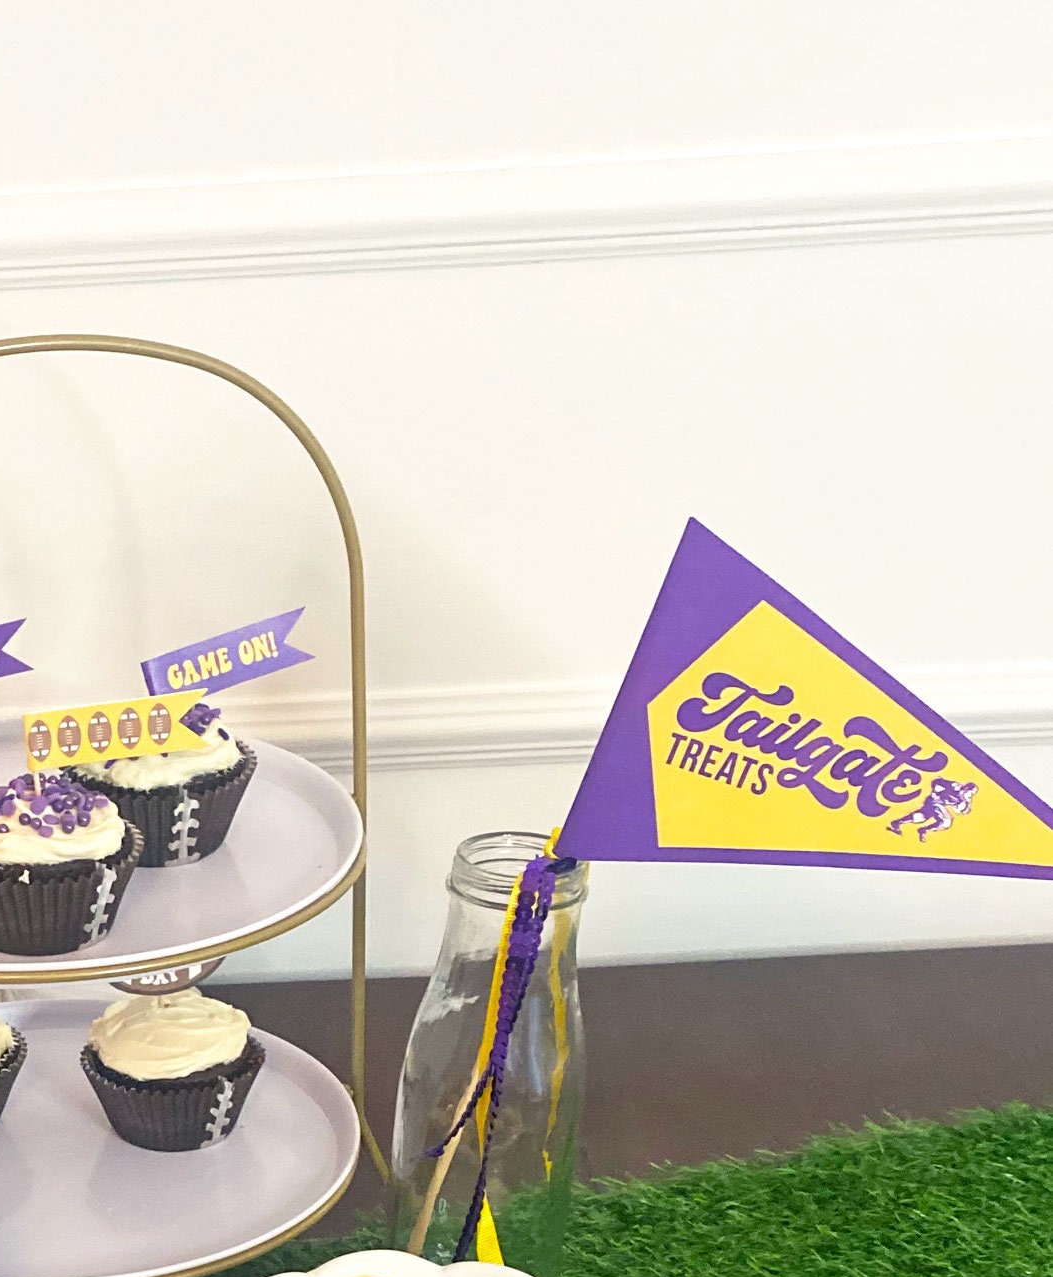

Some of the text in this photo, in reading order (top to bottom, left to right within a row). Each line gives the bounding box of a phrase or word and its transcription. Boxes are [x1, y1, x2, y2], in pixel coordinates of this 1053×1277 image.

[167, 631, 279, 690] GAME ON!
[665, 732, 774, 795] TREATS
[676, 672, 949, 817] Tailgate
